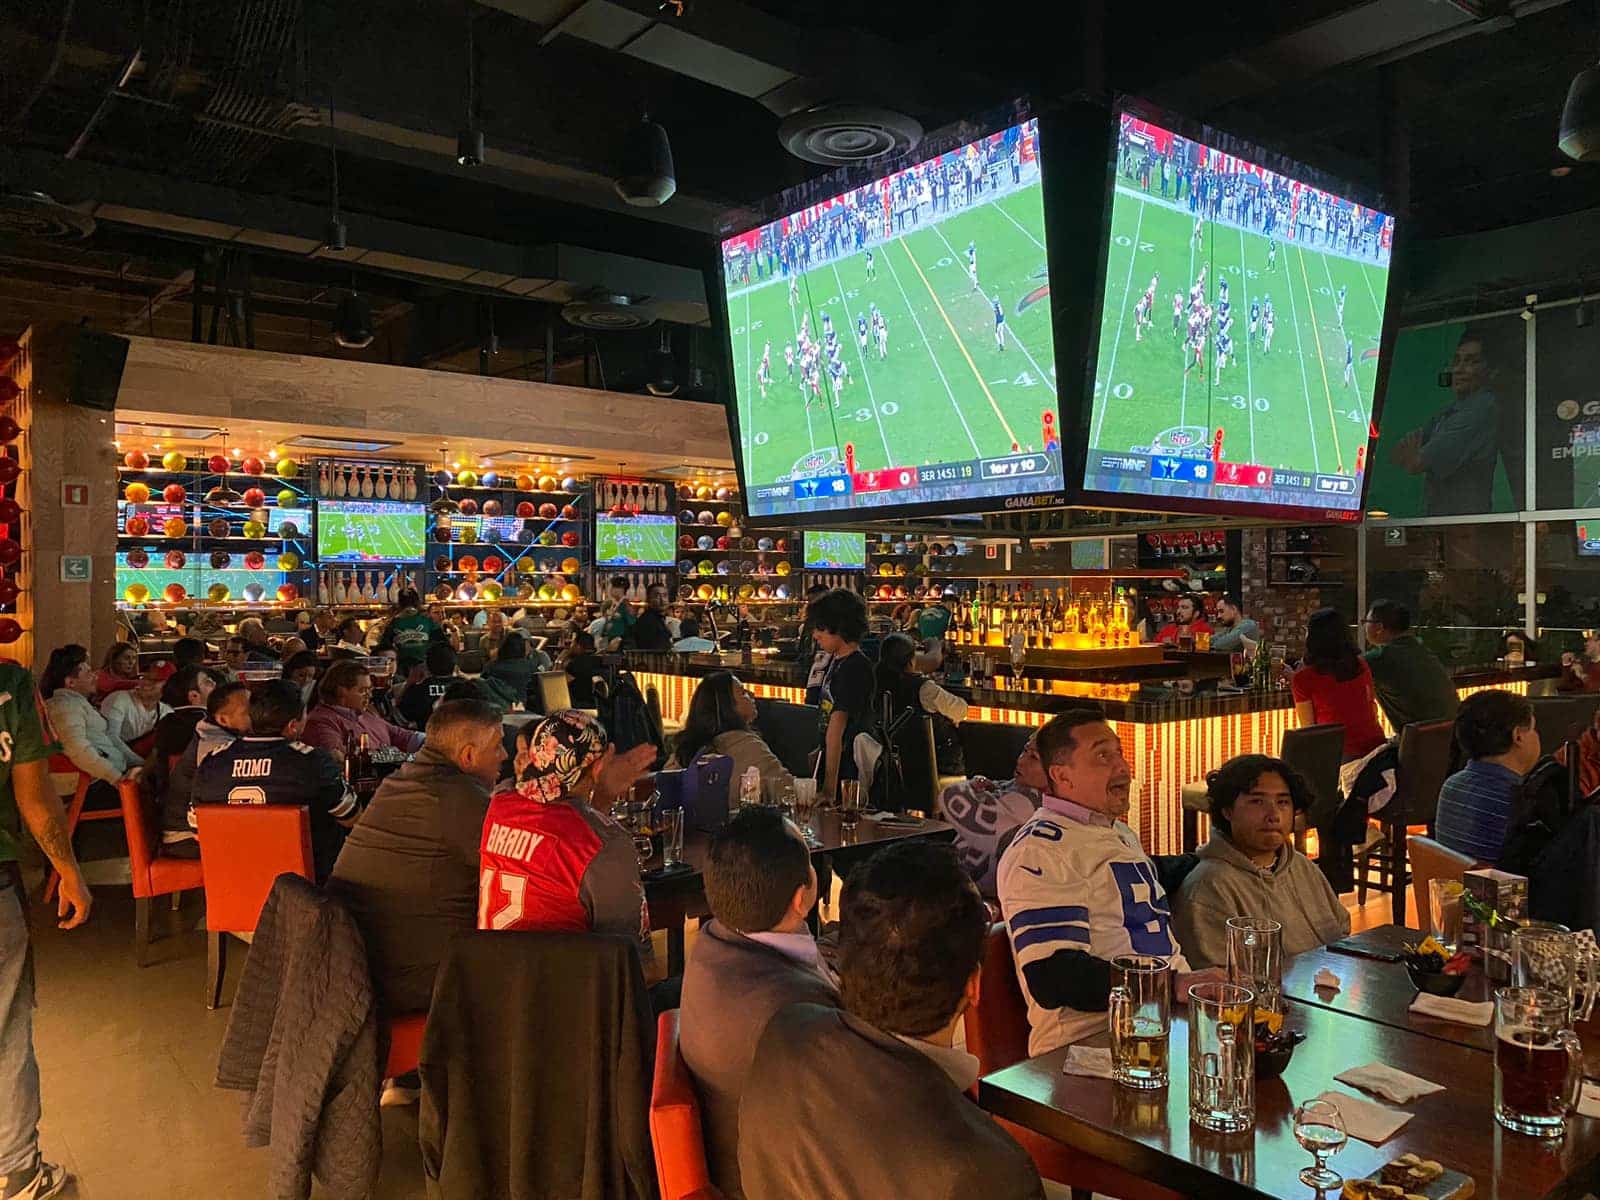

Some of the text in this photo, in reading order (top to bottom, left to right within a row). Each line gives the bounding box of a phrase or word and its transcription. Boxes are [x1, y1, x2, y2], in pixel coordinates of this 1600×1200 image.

[1020, 459, 1035, 471] 10
[1193, 464, 1208, 479] 18
[899, 471, 910, 485] 0
[1257, 471, 1266, 484] 0
[831, 479, 845, 492] 18
[231, 758, 272, 778] ROMO
[486, 822, 545, 863] BRADY
